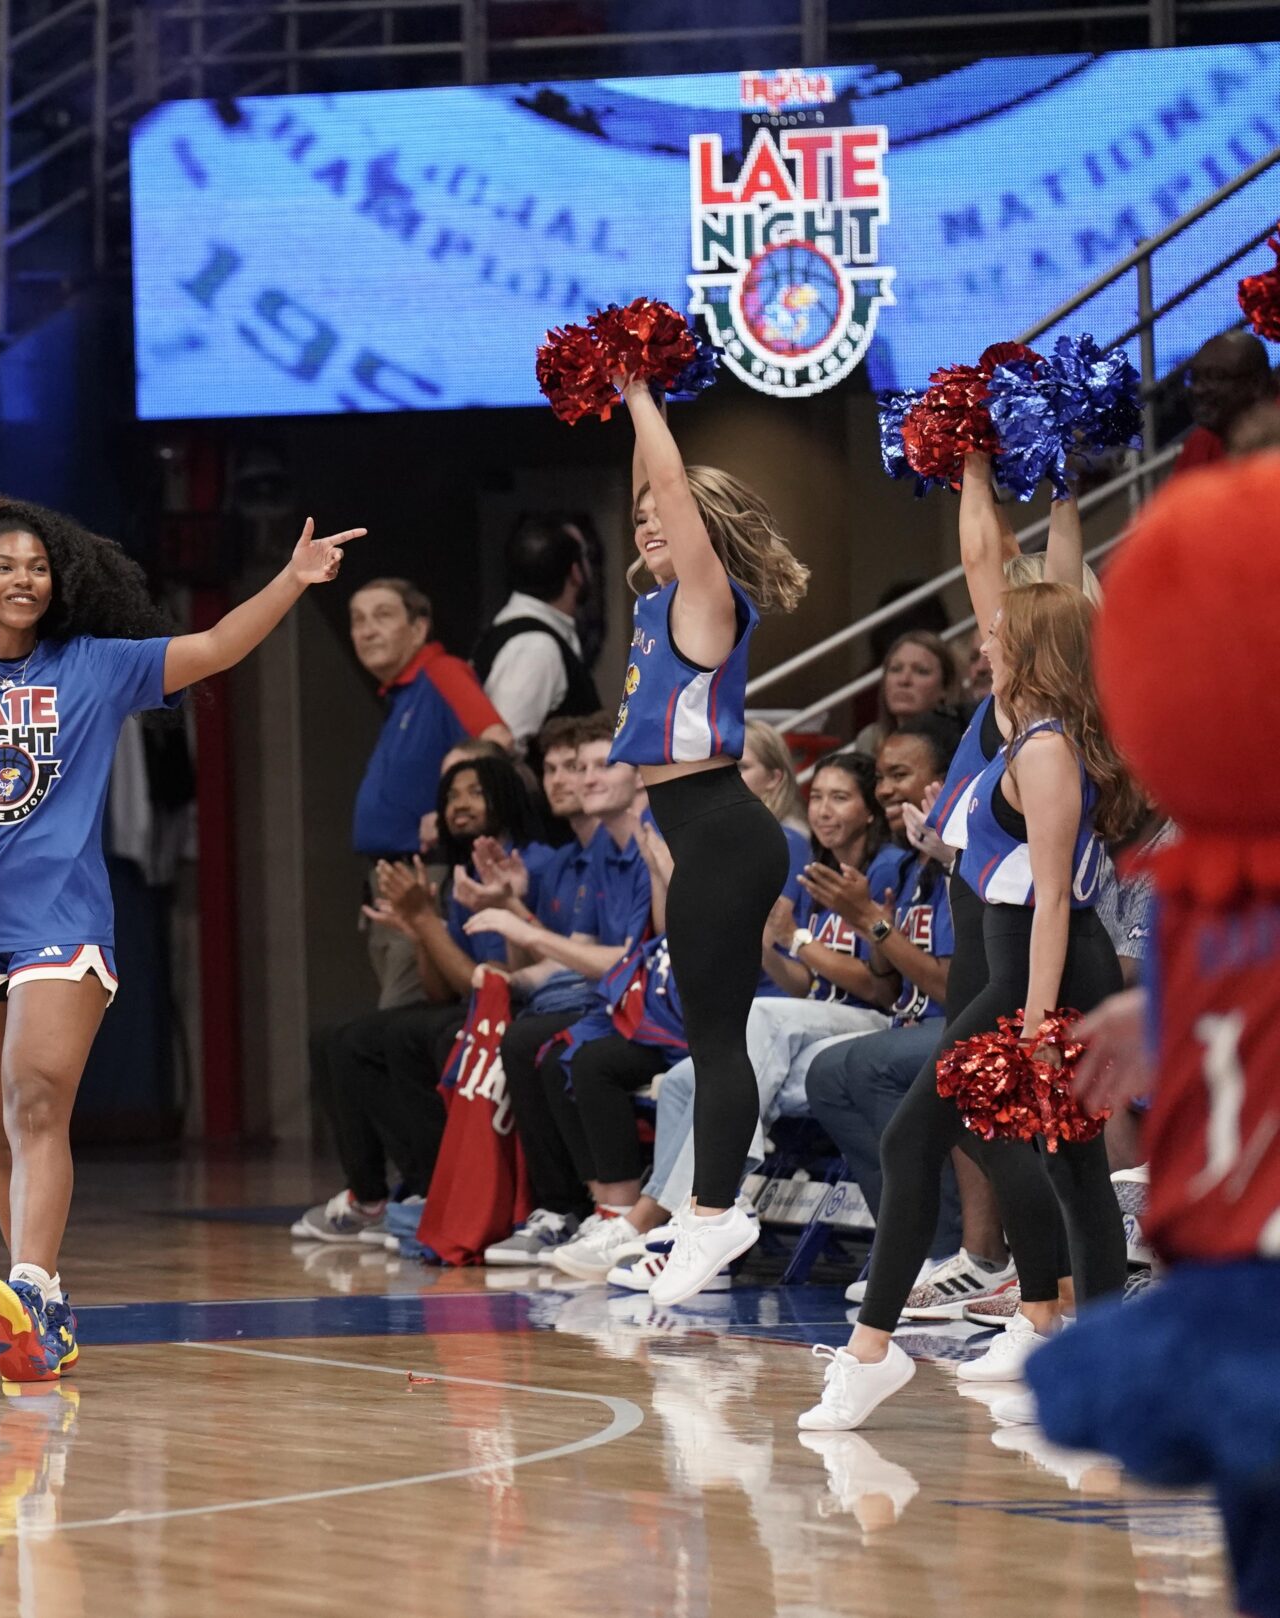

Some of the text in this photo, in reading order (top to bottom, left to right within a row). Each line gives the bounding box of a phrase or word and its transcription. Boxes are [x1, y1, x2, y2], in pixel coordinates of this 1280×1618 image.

[692, 128, 886, 205] LATE
[694, 206, 881, 266] NIGHT
[13, 788, 44, 819] PHOG
